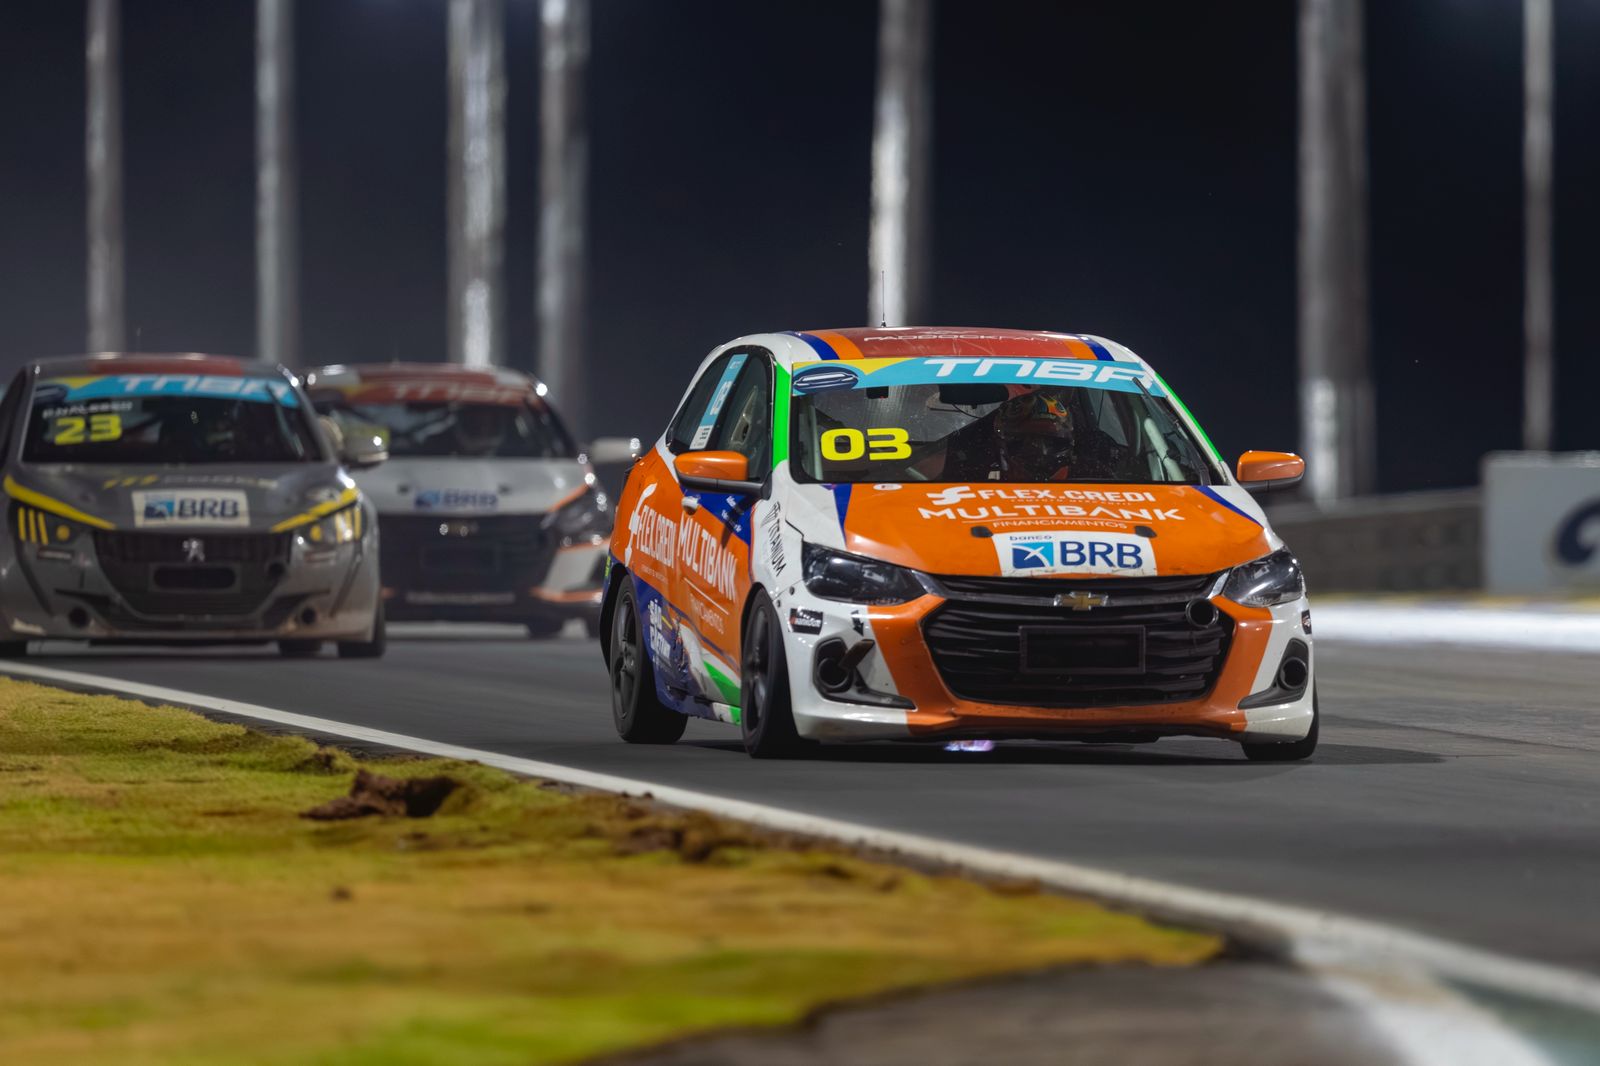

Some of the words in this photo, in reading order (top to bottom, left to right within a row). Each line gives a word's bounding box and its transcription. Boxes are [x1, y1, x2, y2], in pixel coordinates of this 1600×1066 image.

[54, 413, 122, 445] 23
[820, 427, 912, 461] 03
[977, 488, 1156, 503] FLEX.CREDI
[178, 499, 239, 519] BRB
[917, 504, 1186, 521] MULTIBANK
[993, 518, 1128, 529] FINANCIAMENTOS
[768, 518, 787, 577] TITANIUM
[1009, 534, 1052, 542] banco
[677, 510, 738, 604] MULTIBANK
[1060, 540, 1143, 568] BRB
